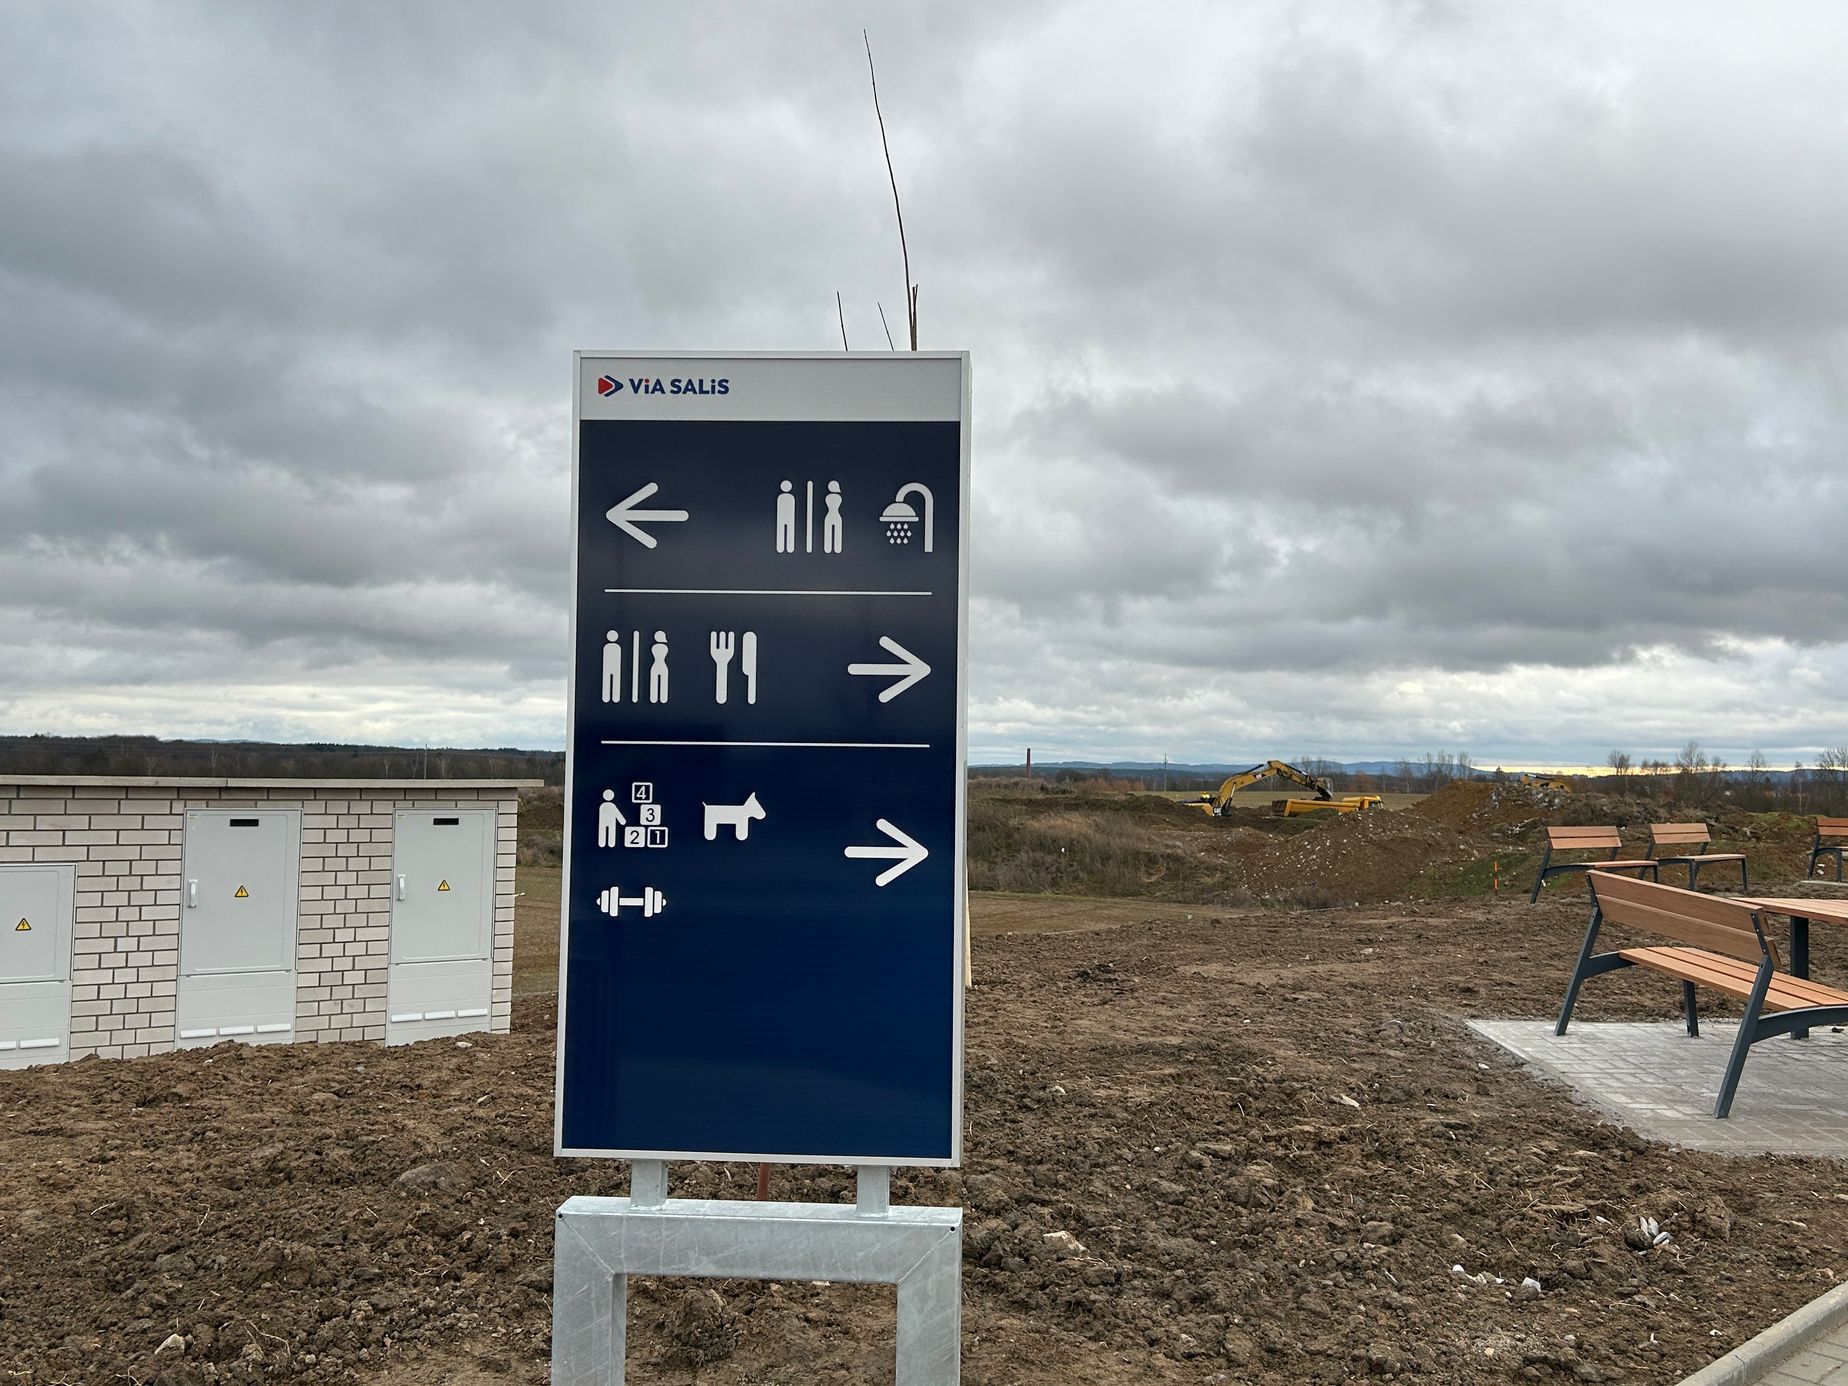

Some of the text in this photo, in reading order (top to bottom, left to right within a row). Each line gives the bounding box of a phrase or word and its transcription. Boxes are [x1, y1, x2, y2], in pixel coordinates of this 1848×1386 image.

[636, 785, 646, 799] 4
[646, 808, 655, 822] 3
[630, 830, 639, 844] 2
[655, 831, 660, 844] 1
